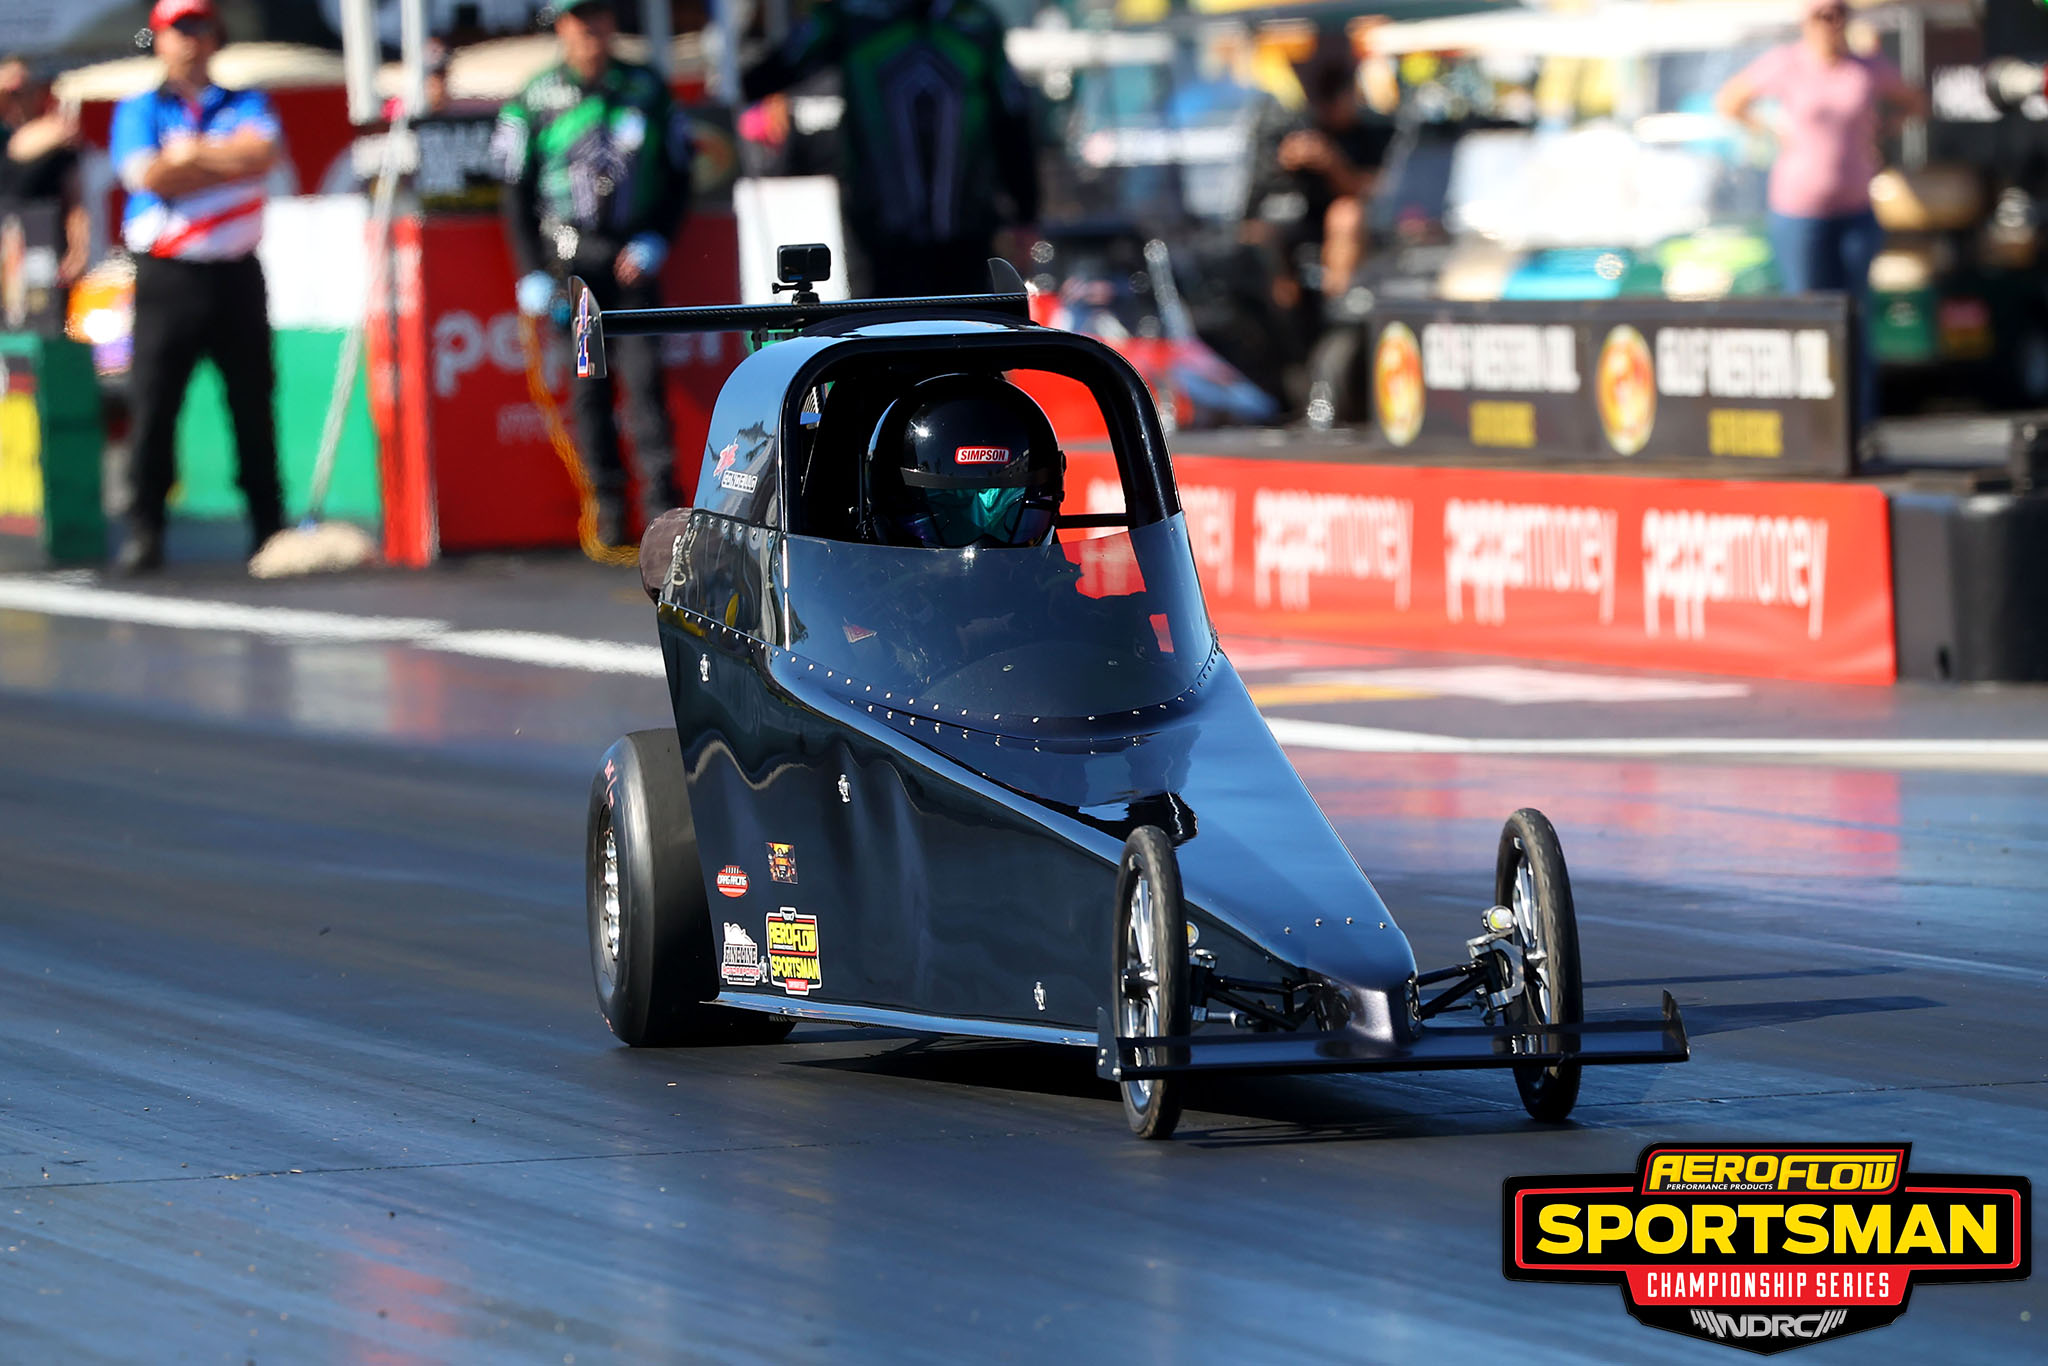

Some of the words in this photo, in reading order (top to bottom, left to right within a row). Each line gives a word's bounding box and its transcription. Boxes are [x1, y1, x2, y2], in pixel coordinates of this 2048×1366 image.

[960, 449, 1006, 461] SIMPSON
[768, 921, 816, 952] AEROFLOW
[771, 955, 820, 979] SPORTSMAN
